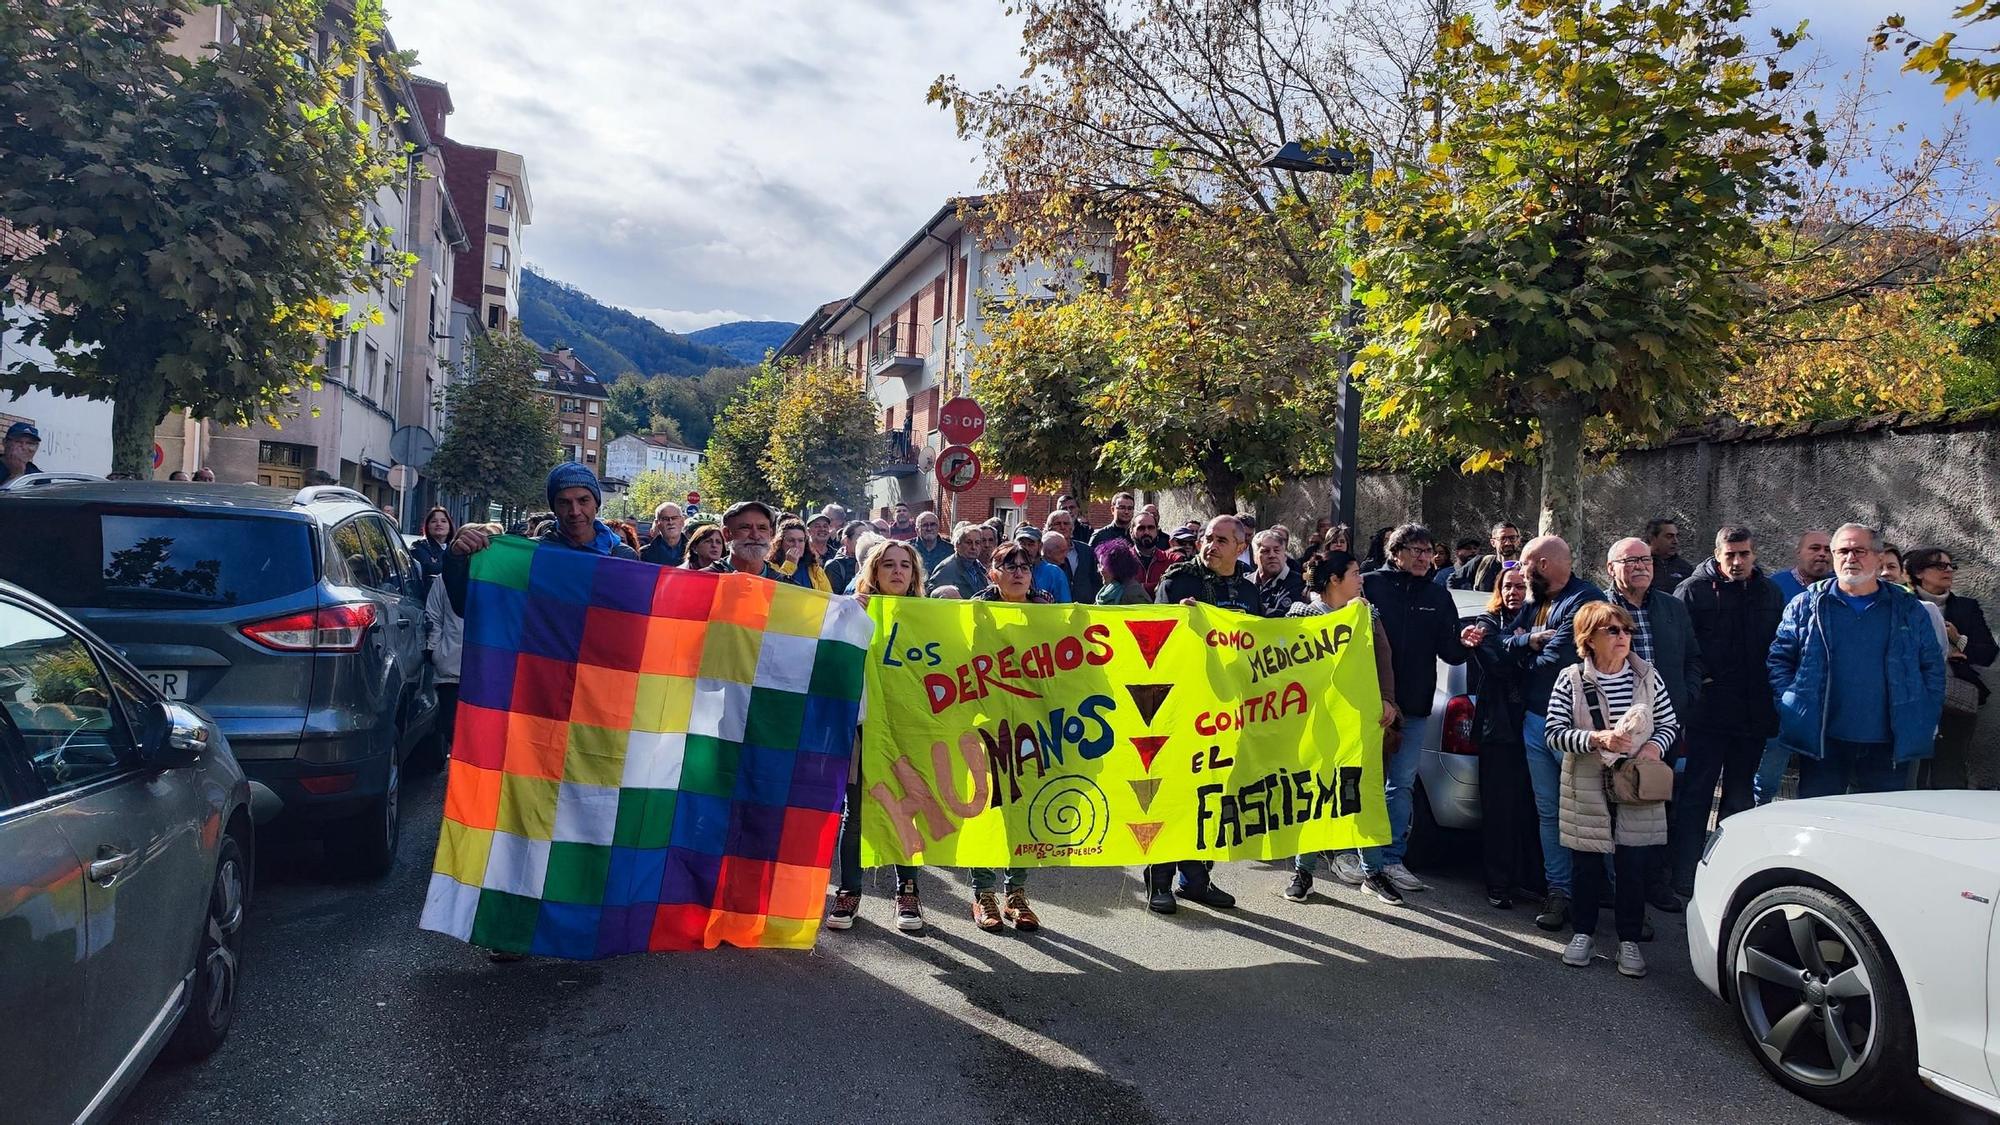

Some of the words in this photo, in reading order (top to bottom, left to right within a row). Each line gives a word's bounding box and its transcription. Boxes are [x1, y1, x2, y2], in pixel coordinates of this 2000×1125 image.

[942, 414, 982, 428] STOP
[1205, 628, 1256, 651] COMO
[922, 623, 1115, 715] DERECHOS
[1194, 681, 1308, 737] CONTRA
[1191, 745, 1235, 774] EL
[868, 694, 1118, 859] HUMANOS
[1015, 843, 1054, 856] ABRAZO
[1036, 851, 1047, 859] DE
[1052, 849, 1066, 857] LOS
[1067, 846, 1103, 857] PUEBLOS
